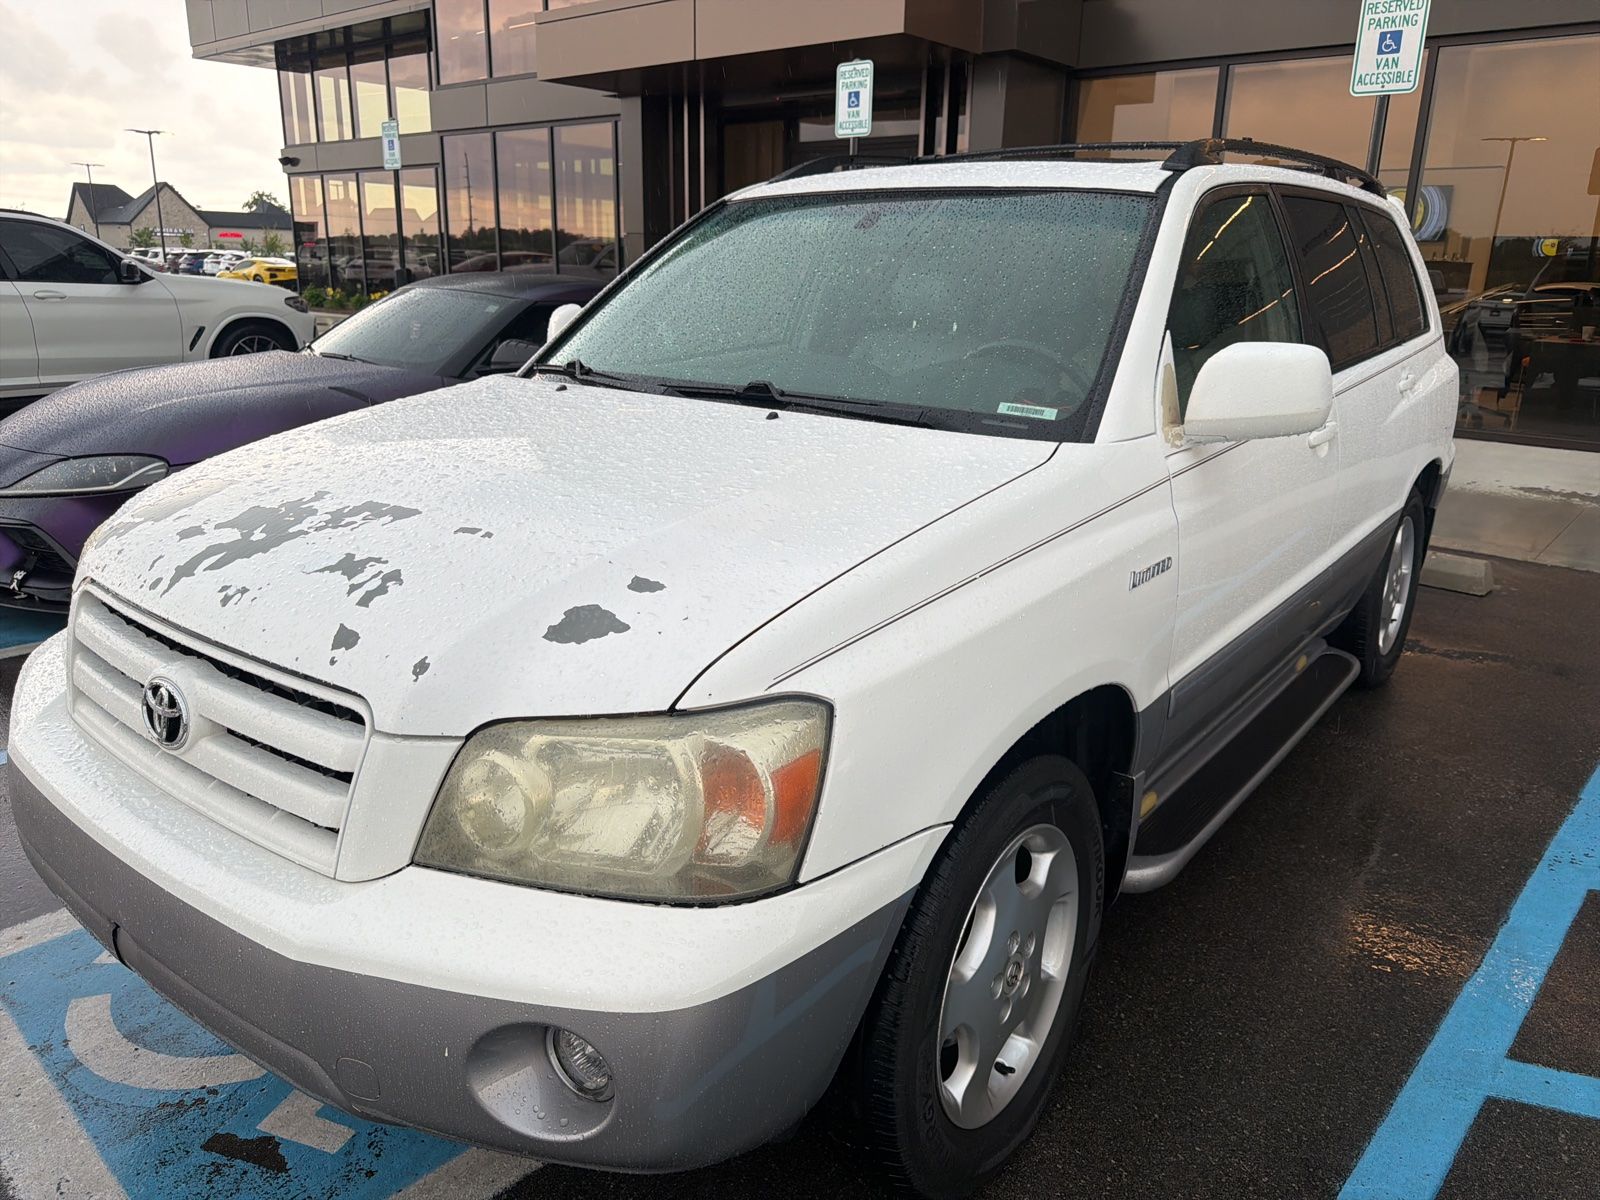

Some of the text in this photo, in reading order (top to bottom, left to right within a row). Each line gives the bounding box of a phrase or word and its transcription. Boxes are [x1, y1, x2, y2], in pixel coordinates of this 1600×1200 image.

[1366, 0, 1425, 15] RESERVED
[1368, 14, 1419, 30] PARKING
[1376, 57, 1399, 70] VAN
[840, 67, 869, 80] RESERVED
[1356, 70, 1414, 87] ACCESSIBLE
[841, 79, 868, 91] PARKING
[847, 110, 860, 119] VAN
